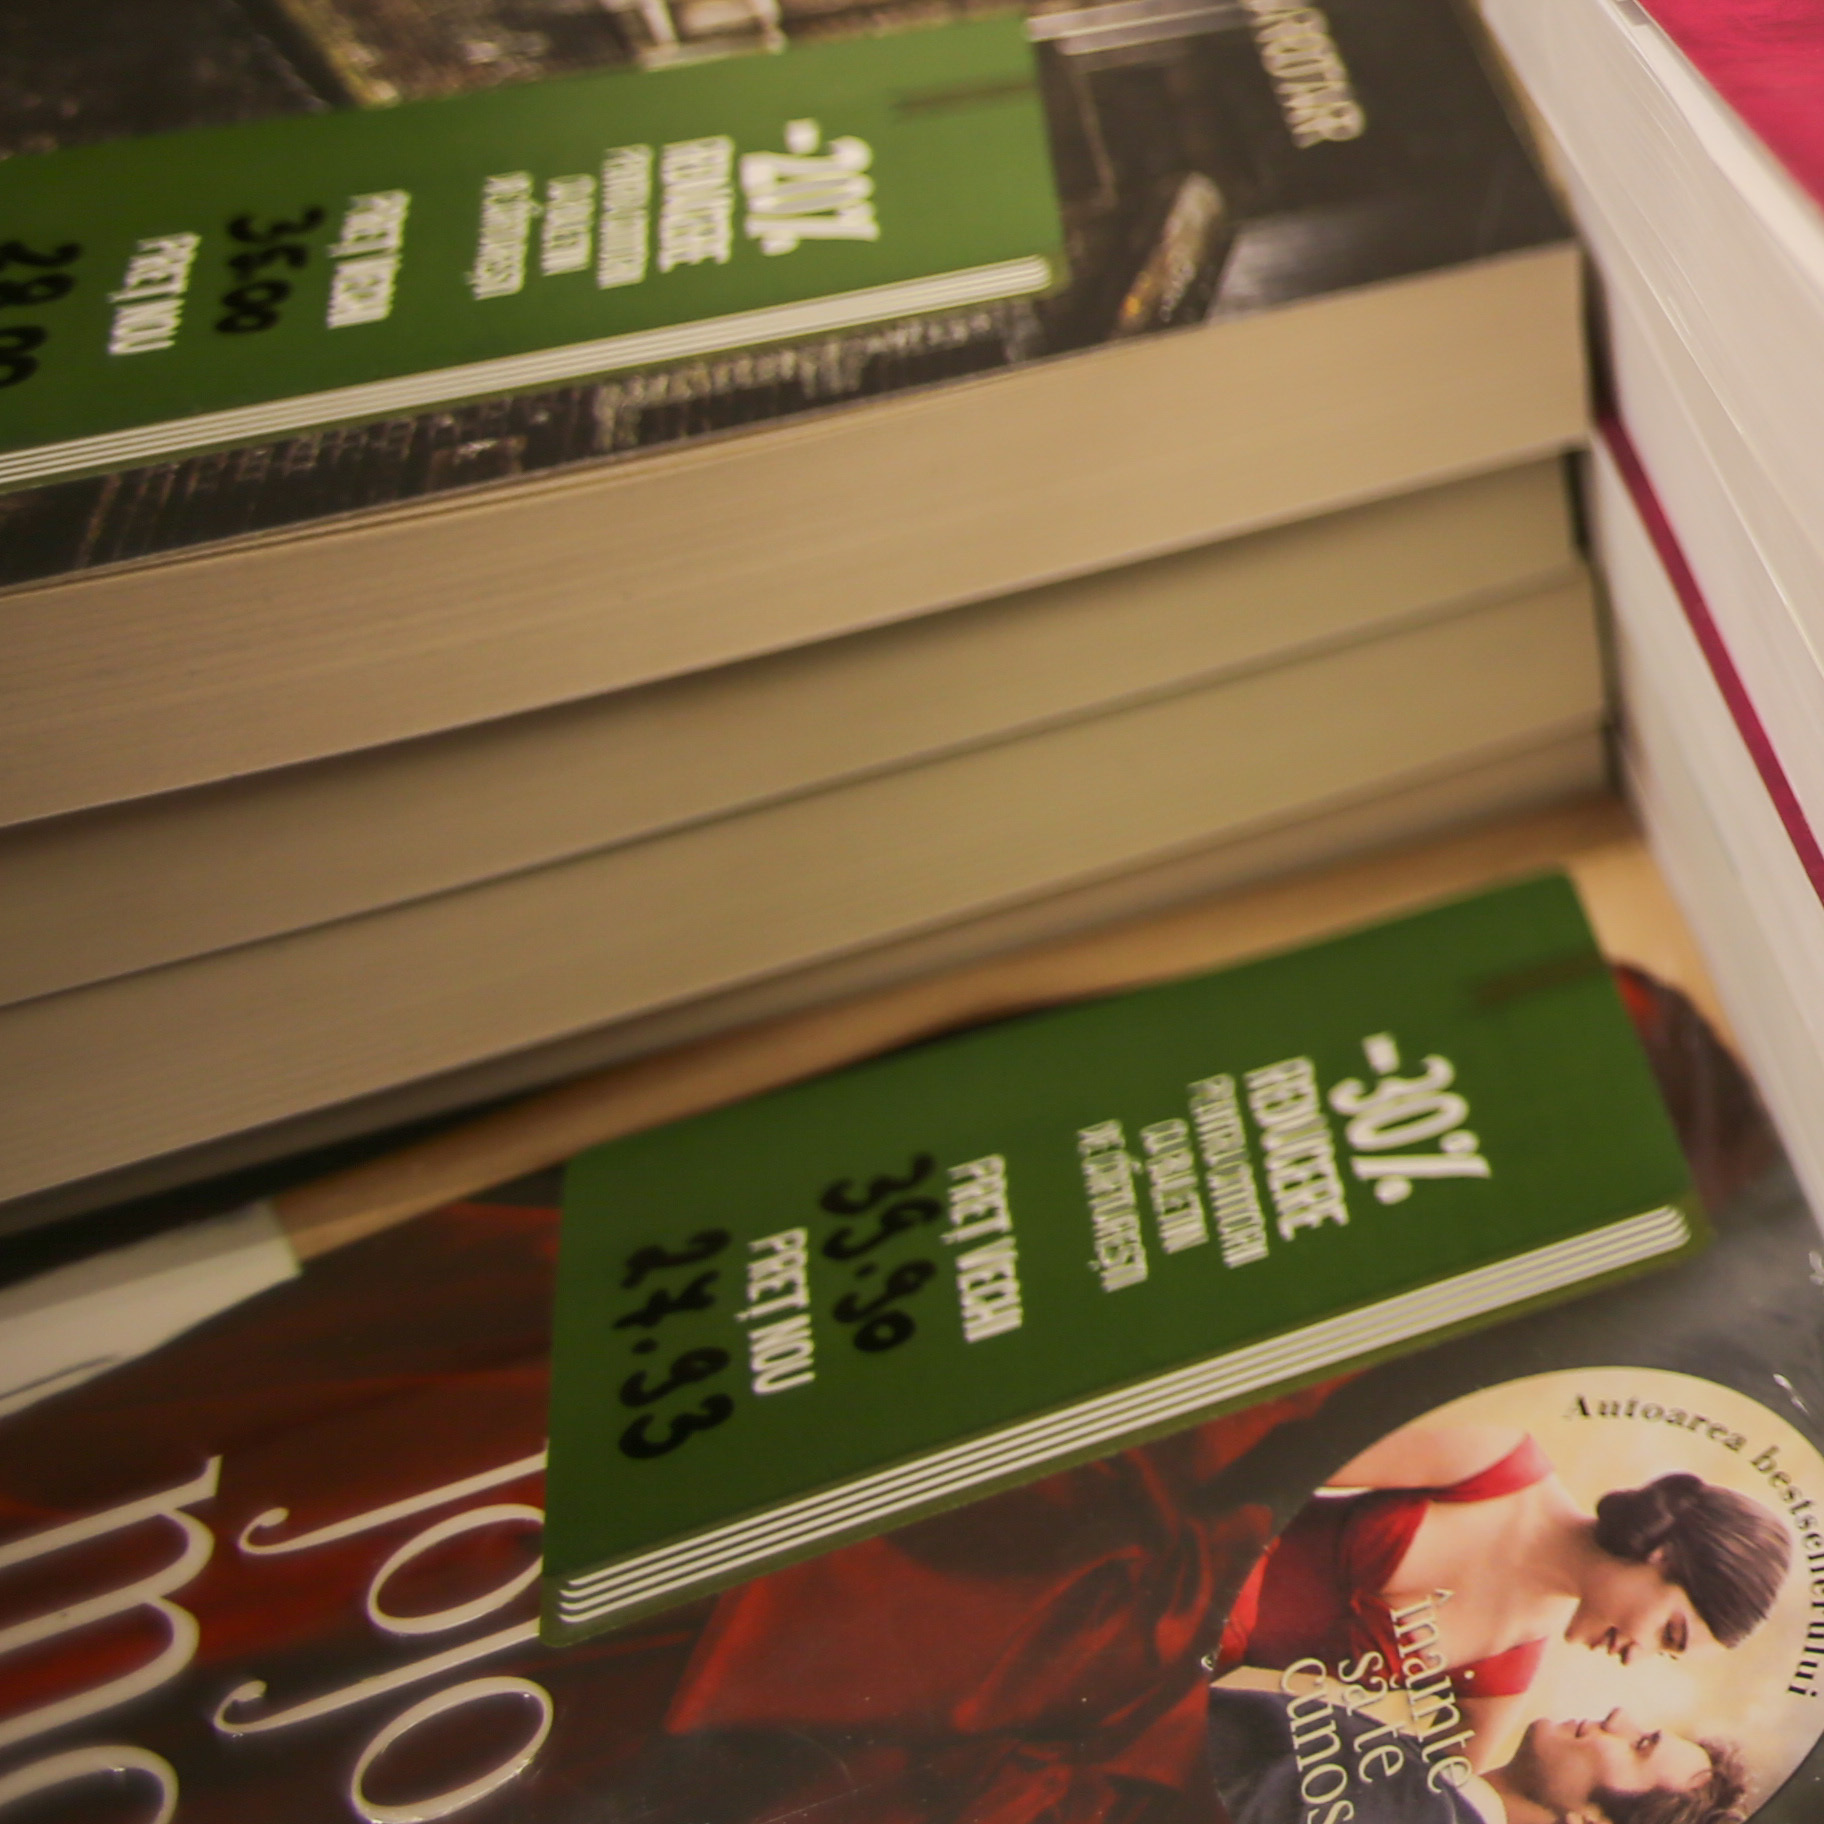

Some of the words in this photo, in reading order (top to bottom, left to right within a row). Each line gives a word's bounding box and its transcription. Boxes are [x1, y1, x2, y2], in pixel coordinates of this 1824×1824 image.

[740, 118, 881, 256] -20%
[1328, 1032, 1490, 1205] -30%
[940, 1154, 1012, 1245] PREȚ
[735, 1227, 811, 1322] PREȚ
[819, 1152, 943, 1354] 39.90
[748, 1314, 815, 1396] NOU
[1566, 1393, 1747, 1453] Autoarea
[1338, 1651, 1399, 1716] să
[1354, 1721, 1406, 1784] te
